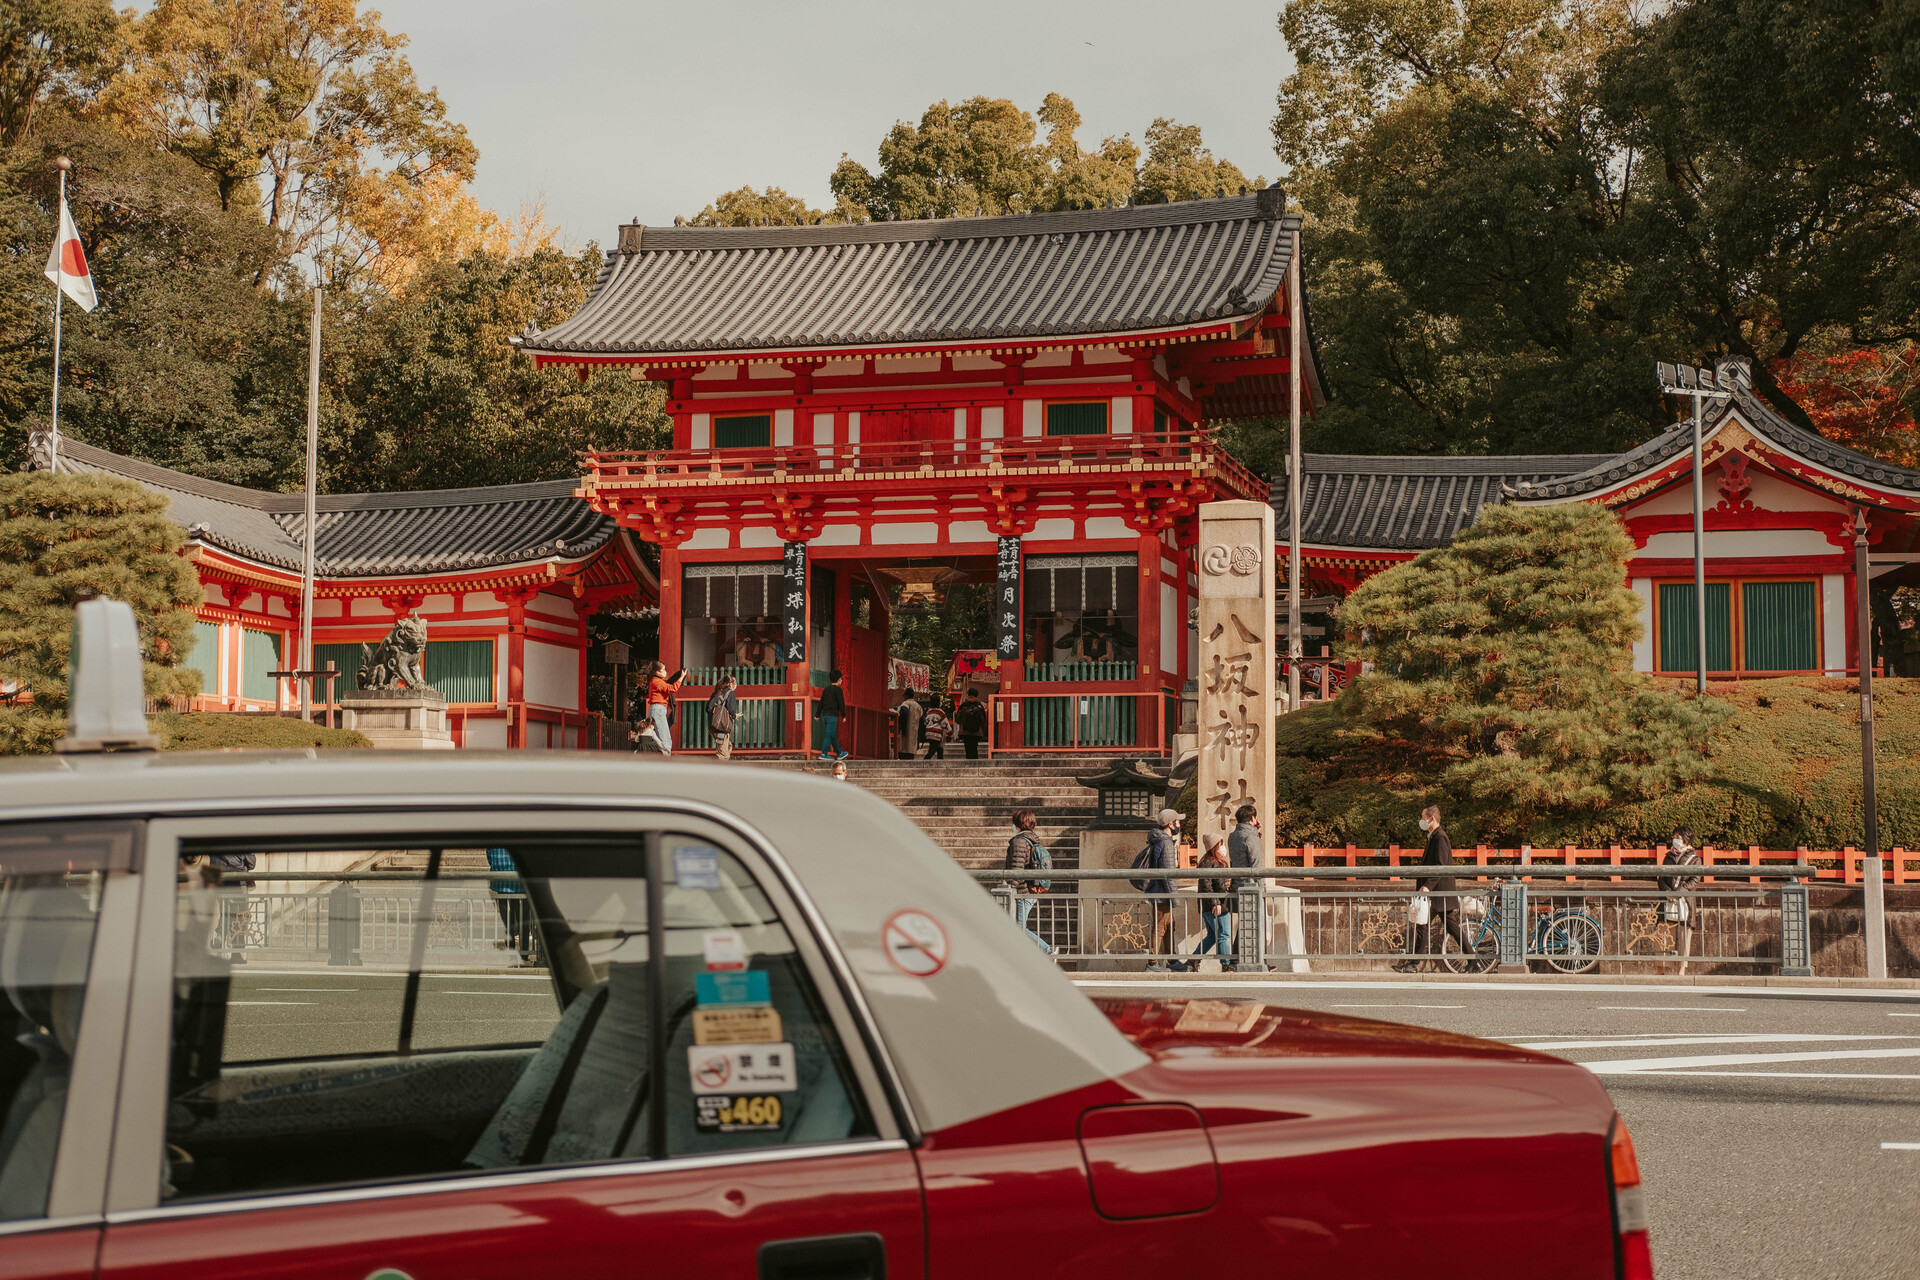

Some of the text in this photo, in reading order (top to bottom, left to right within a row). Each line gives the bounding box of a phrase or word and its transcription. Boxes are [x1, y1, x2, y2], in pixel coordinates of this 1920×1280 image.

[999, 587, 1017, 654] 月次祭
[1202, 613, 1262, 831] 八坂神社
